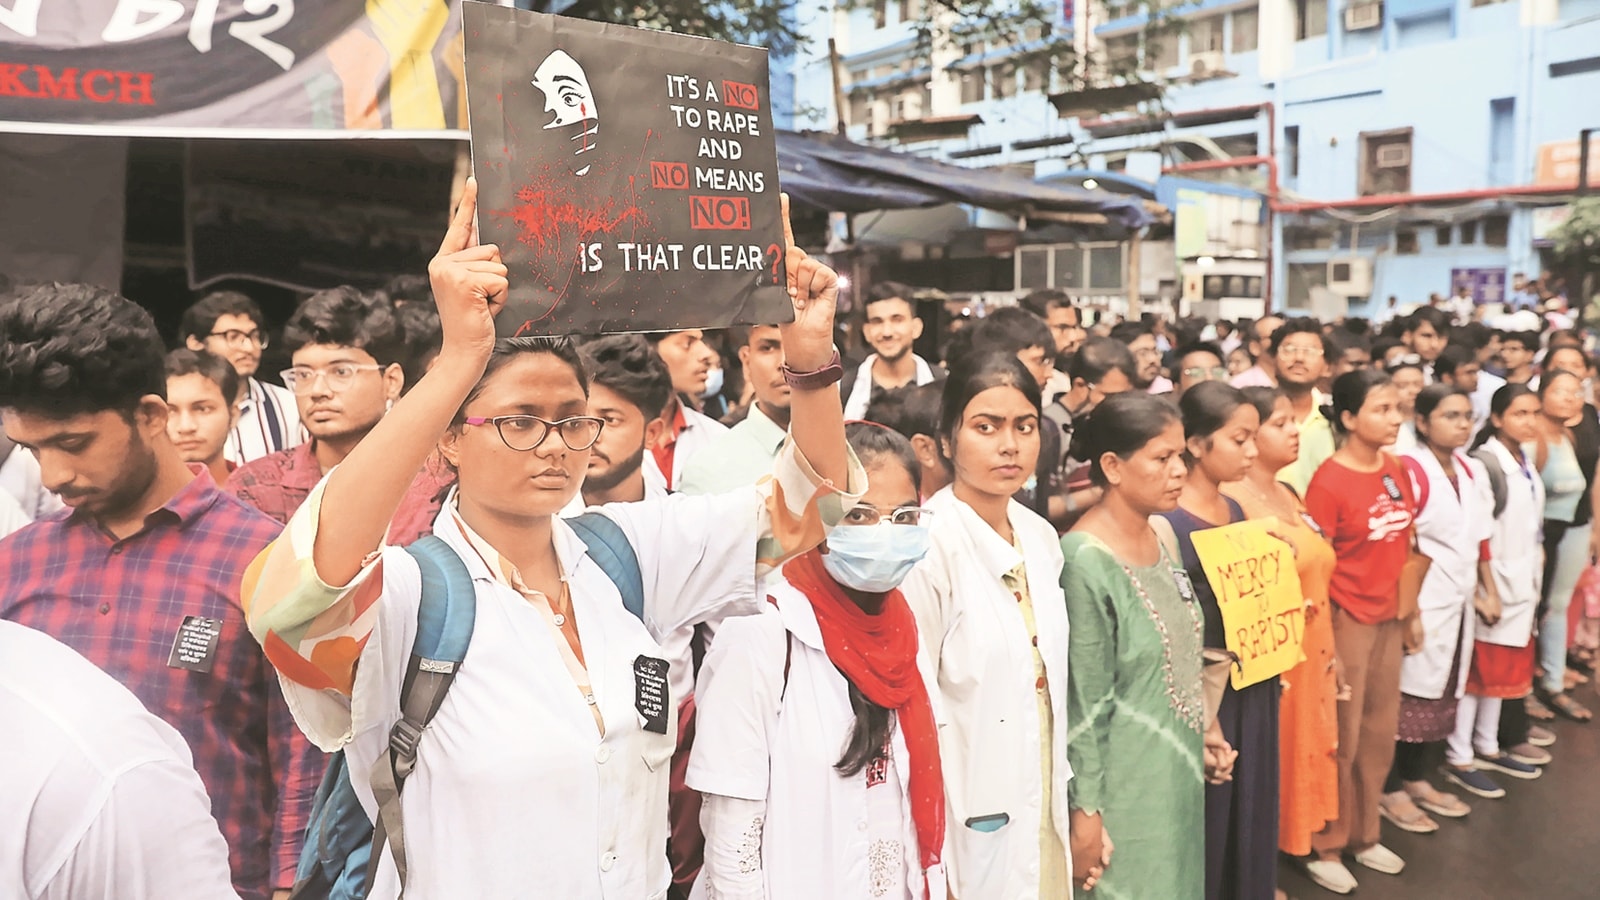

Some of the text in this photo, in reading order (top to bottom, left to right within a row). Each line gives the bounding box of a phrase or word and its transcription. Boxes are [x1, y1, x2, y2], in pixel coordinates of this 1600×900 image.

[705, 80, 720, 103] A
[724, 83, 756, 107] NO
[670, 105, 760, 137] TO RAPE
[698, 137, 743, 160] AND
[653, 164, 765, 193] NO MEANS
[693, 197, 748, 228] NO!
[580, 242, 603, 272] IS
[617, 243, 684, 272] THAT
[1216, 550, 1281, 603] MERCY
[1236, 607, 1301, 663] RAPIST
